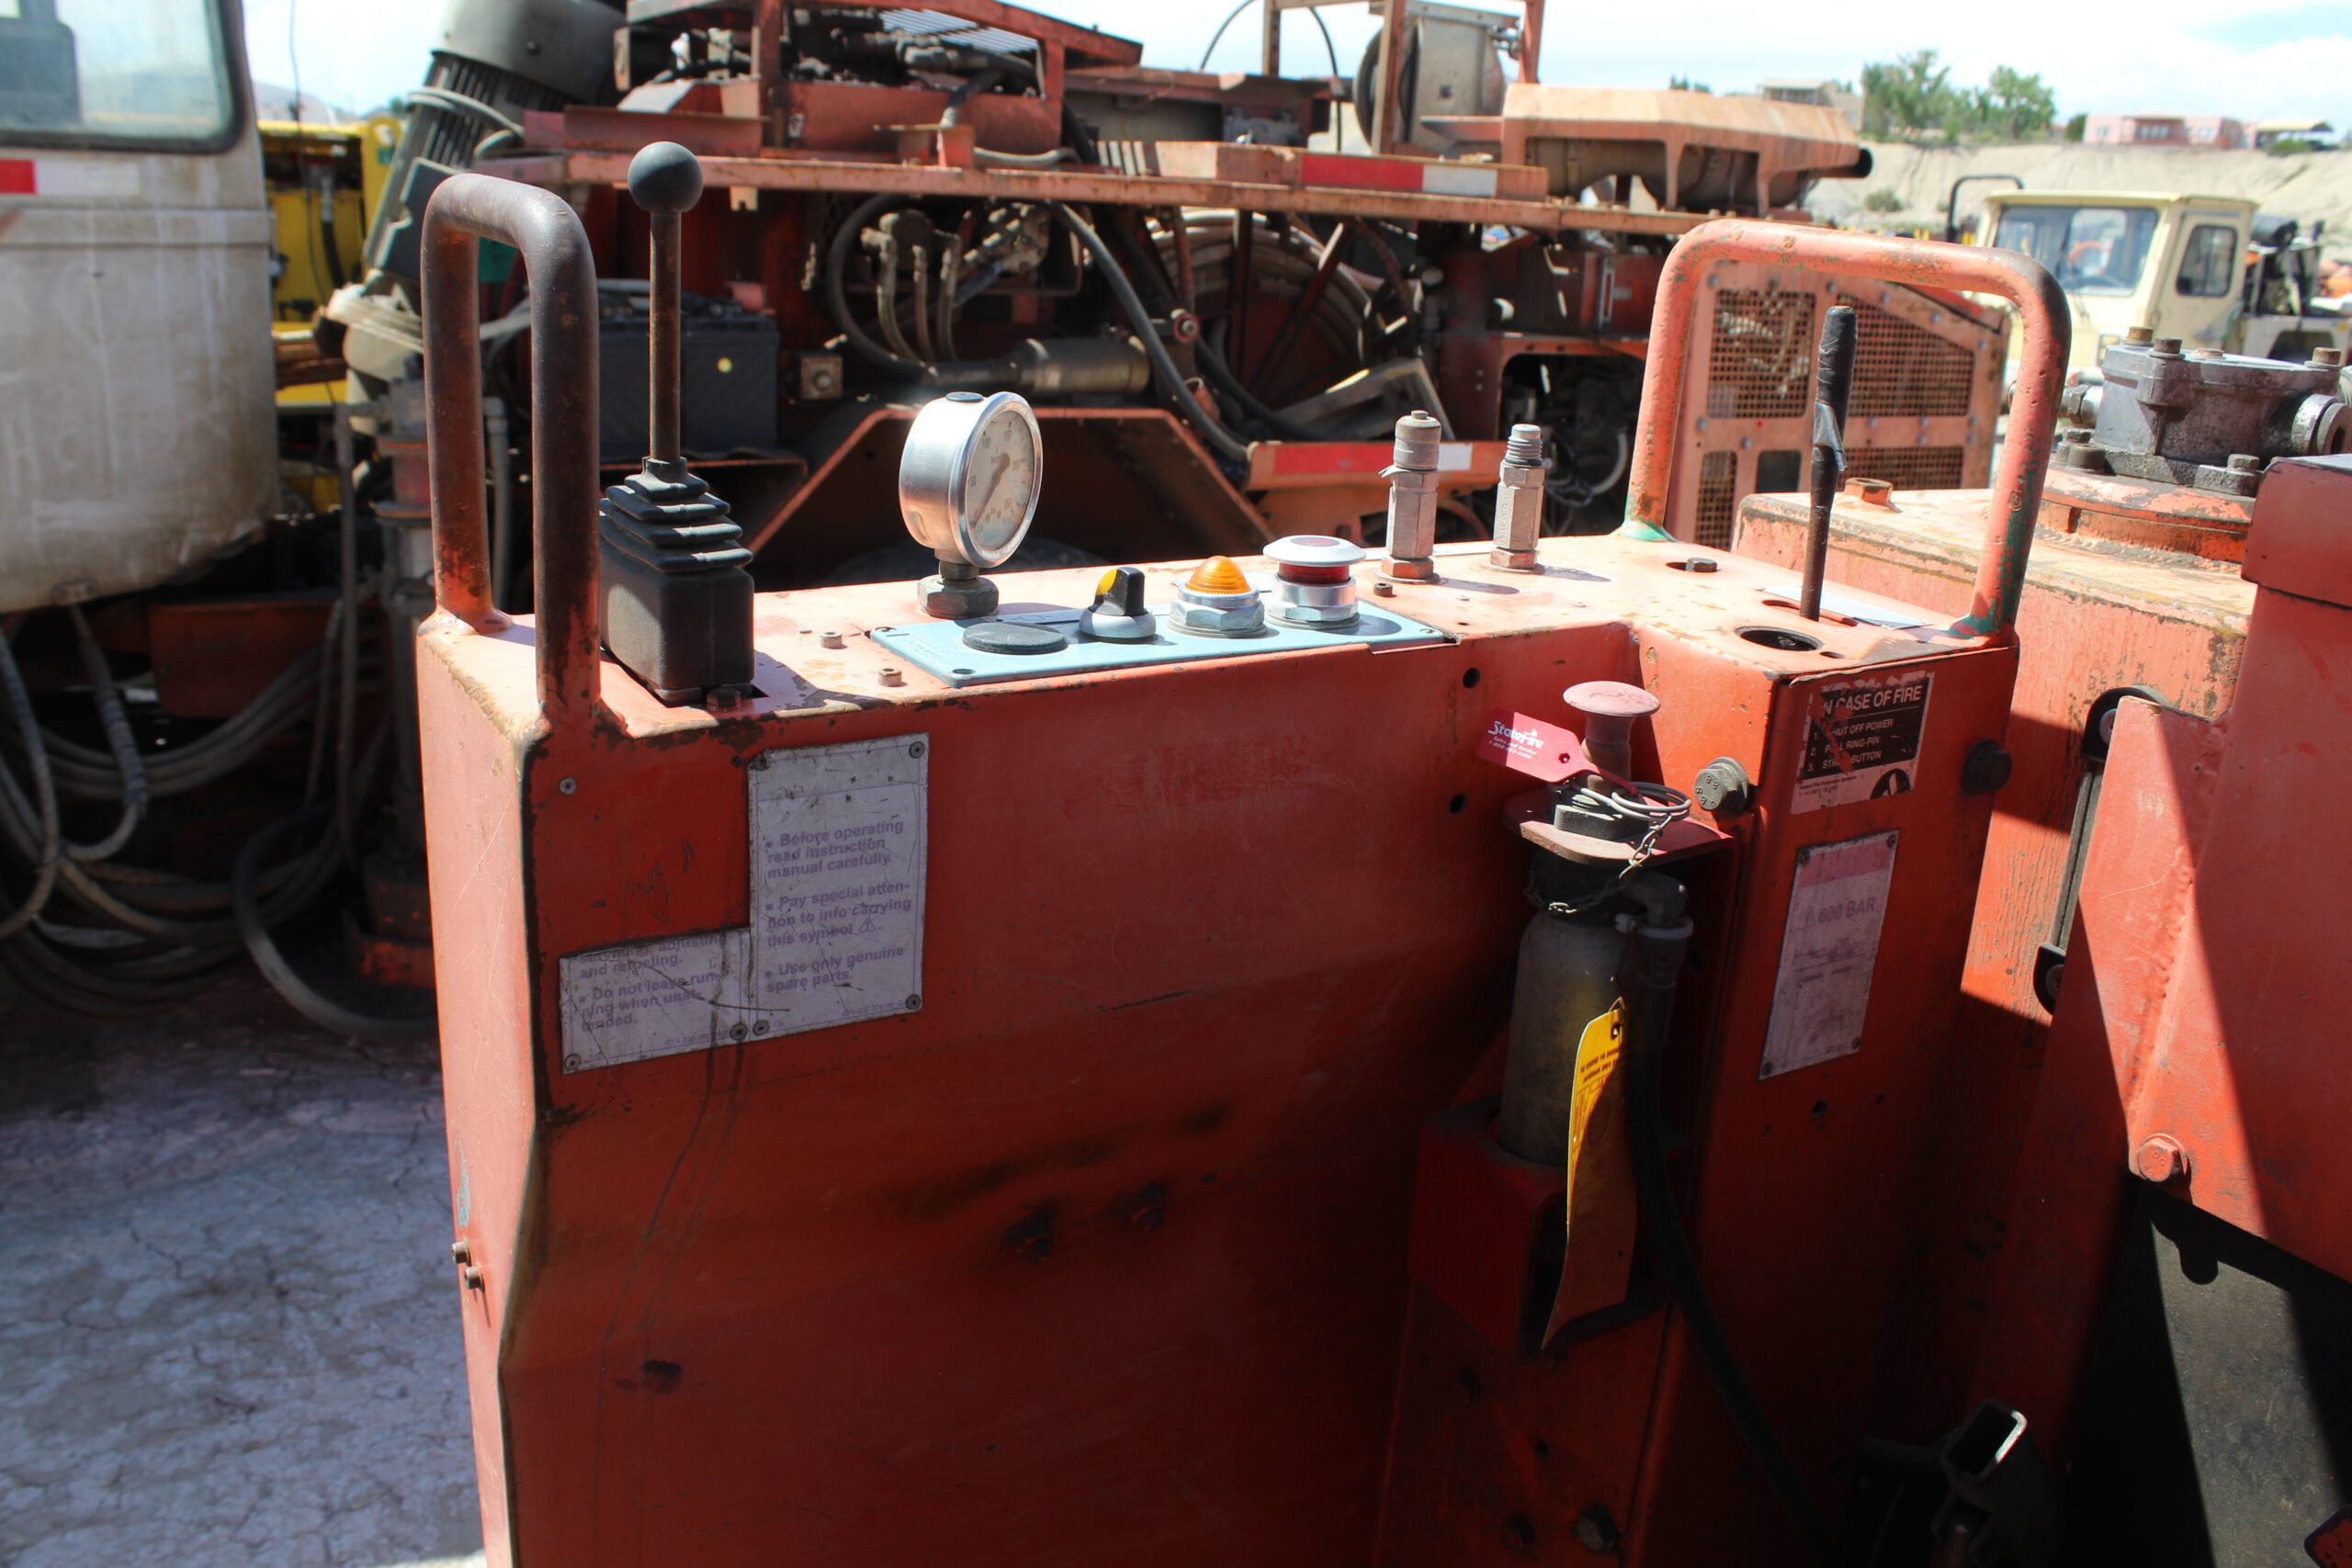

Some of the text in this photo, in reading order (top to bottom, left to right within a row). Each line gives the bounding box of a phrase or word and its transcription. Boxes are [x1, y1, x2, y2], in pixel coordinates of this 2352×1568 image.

[1872, 689, 1893, 707] OF
[1893, 684, 1923, 705] FIRE
[1849, 723, 1865, 735] OFF
[1866, 718, 1894, 732] POWER
[1845, 736, 1880, 750] RING-PIN
[1850, 750, 1883, 763] BUTTON
[780, 821, 904, 847] Before operating
[767, 838, 886, 863] read instruction
[767, 861, 822, 879] manual
[780, 895, 807, 909] Pay
[811, 886, 864, 907] special
[820, 906, 848, 921] info
[852, 898, 912, 917] carrying
[767, 932, 795, 948] this
[778, 947, 905, 976] Use only genuine
[580, 964, 607, 979] and
[593, 987, 614, 1000] Do
[618, 982, 643, 997] not
[766, 976, 808, 994] spare
[618, 996, 659, 1011] when
